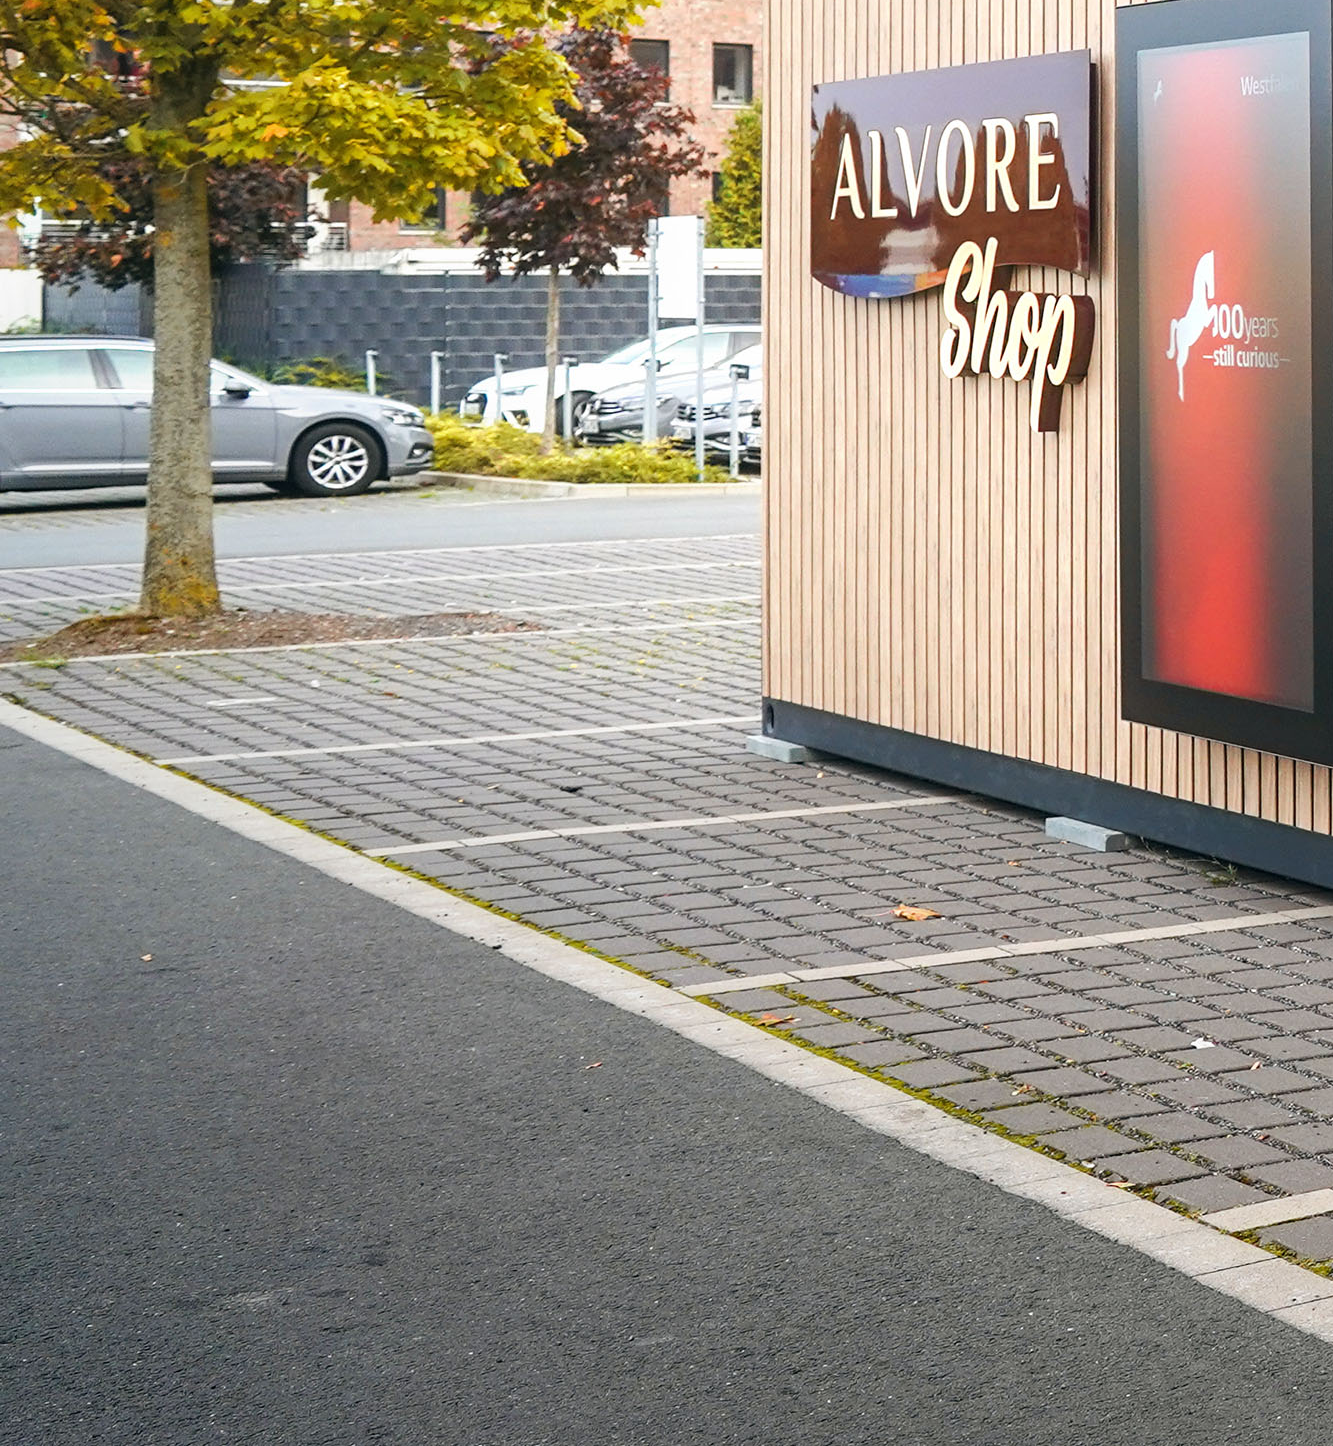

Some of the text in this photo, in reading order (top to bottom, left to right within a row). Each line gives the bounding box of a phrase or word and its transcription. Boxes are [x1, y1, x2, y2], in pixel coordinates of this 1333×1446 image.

[830, 112, 1062, 220] ALVORE
[939, 236, 1076, 433] Shop
[1212, 344, 1281, 369] still curious
